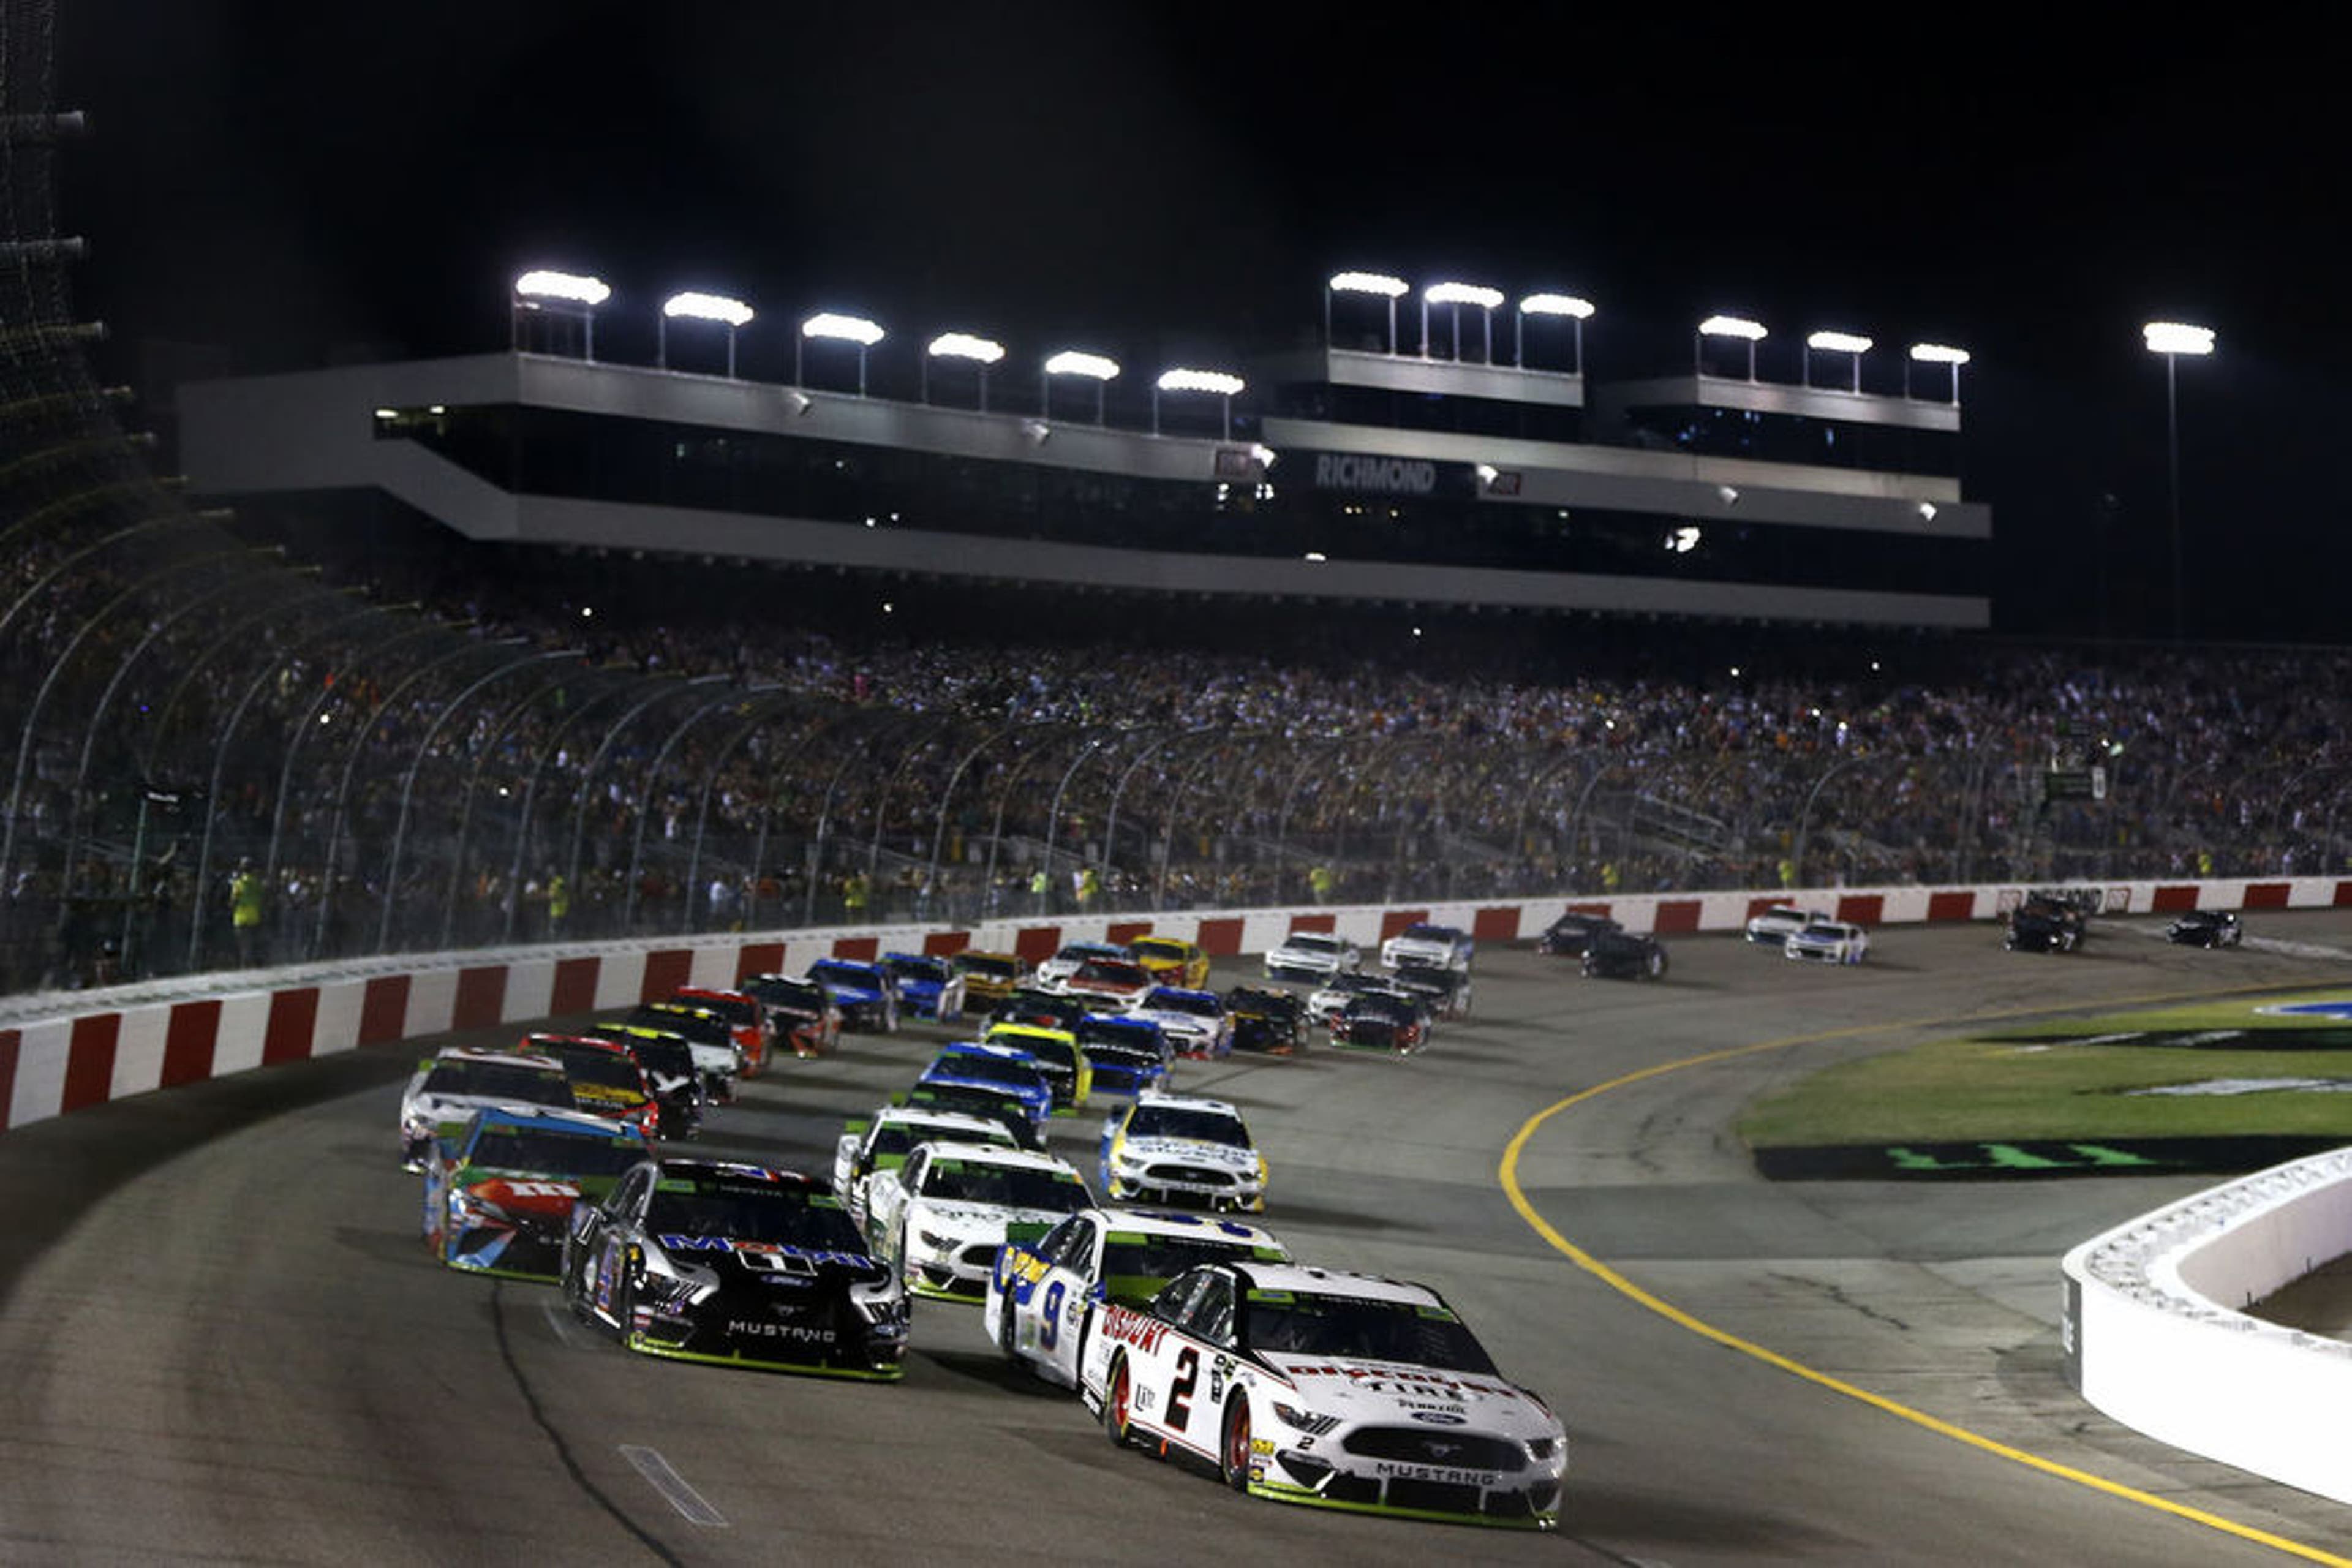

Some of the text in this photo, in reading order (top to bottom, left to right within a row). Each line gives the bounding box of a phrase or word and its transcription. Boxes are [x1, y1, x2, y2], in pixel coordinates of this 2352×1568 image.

[1316, 455, 1435, 491] RICHMOND
[728, 1319, 837, 1343] MUSTANG
[1040, 1281, 1065, 1351] 9
[1164, 1346, 1200, 1433] 2
[1297, 1436, 1315, 1450] 2
[1376, 1463, 1495, 1485] MUSTANG
